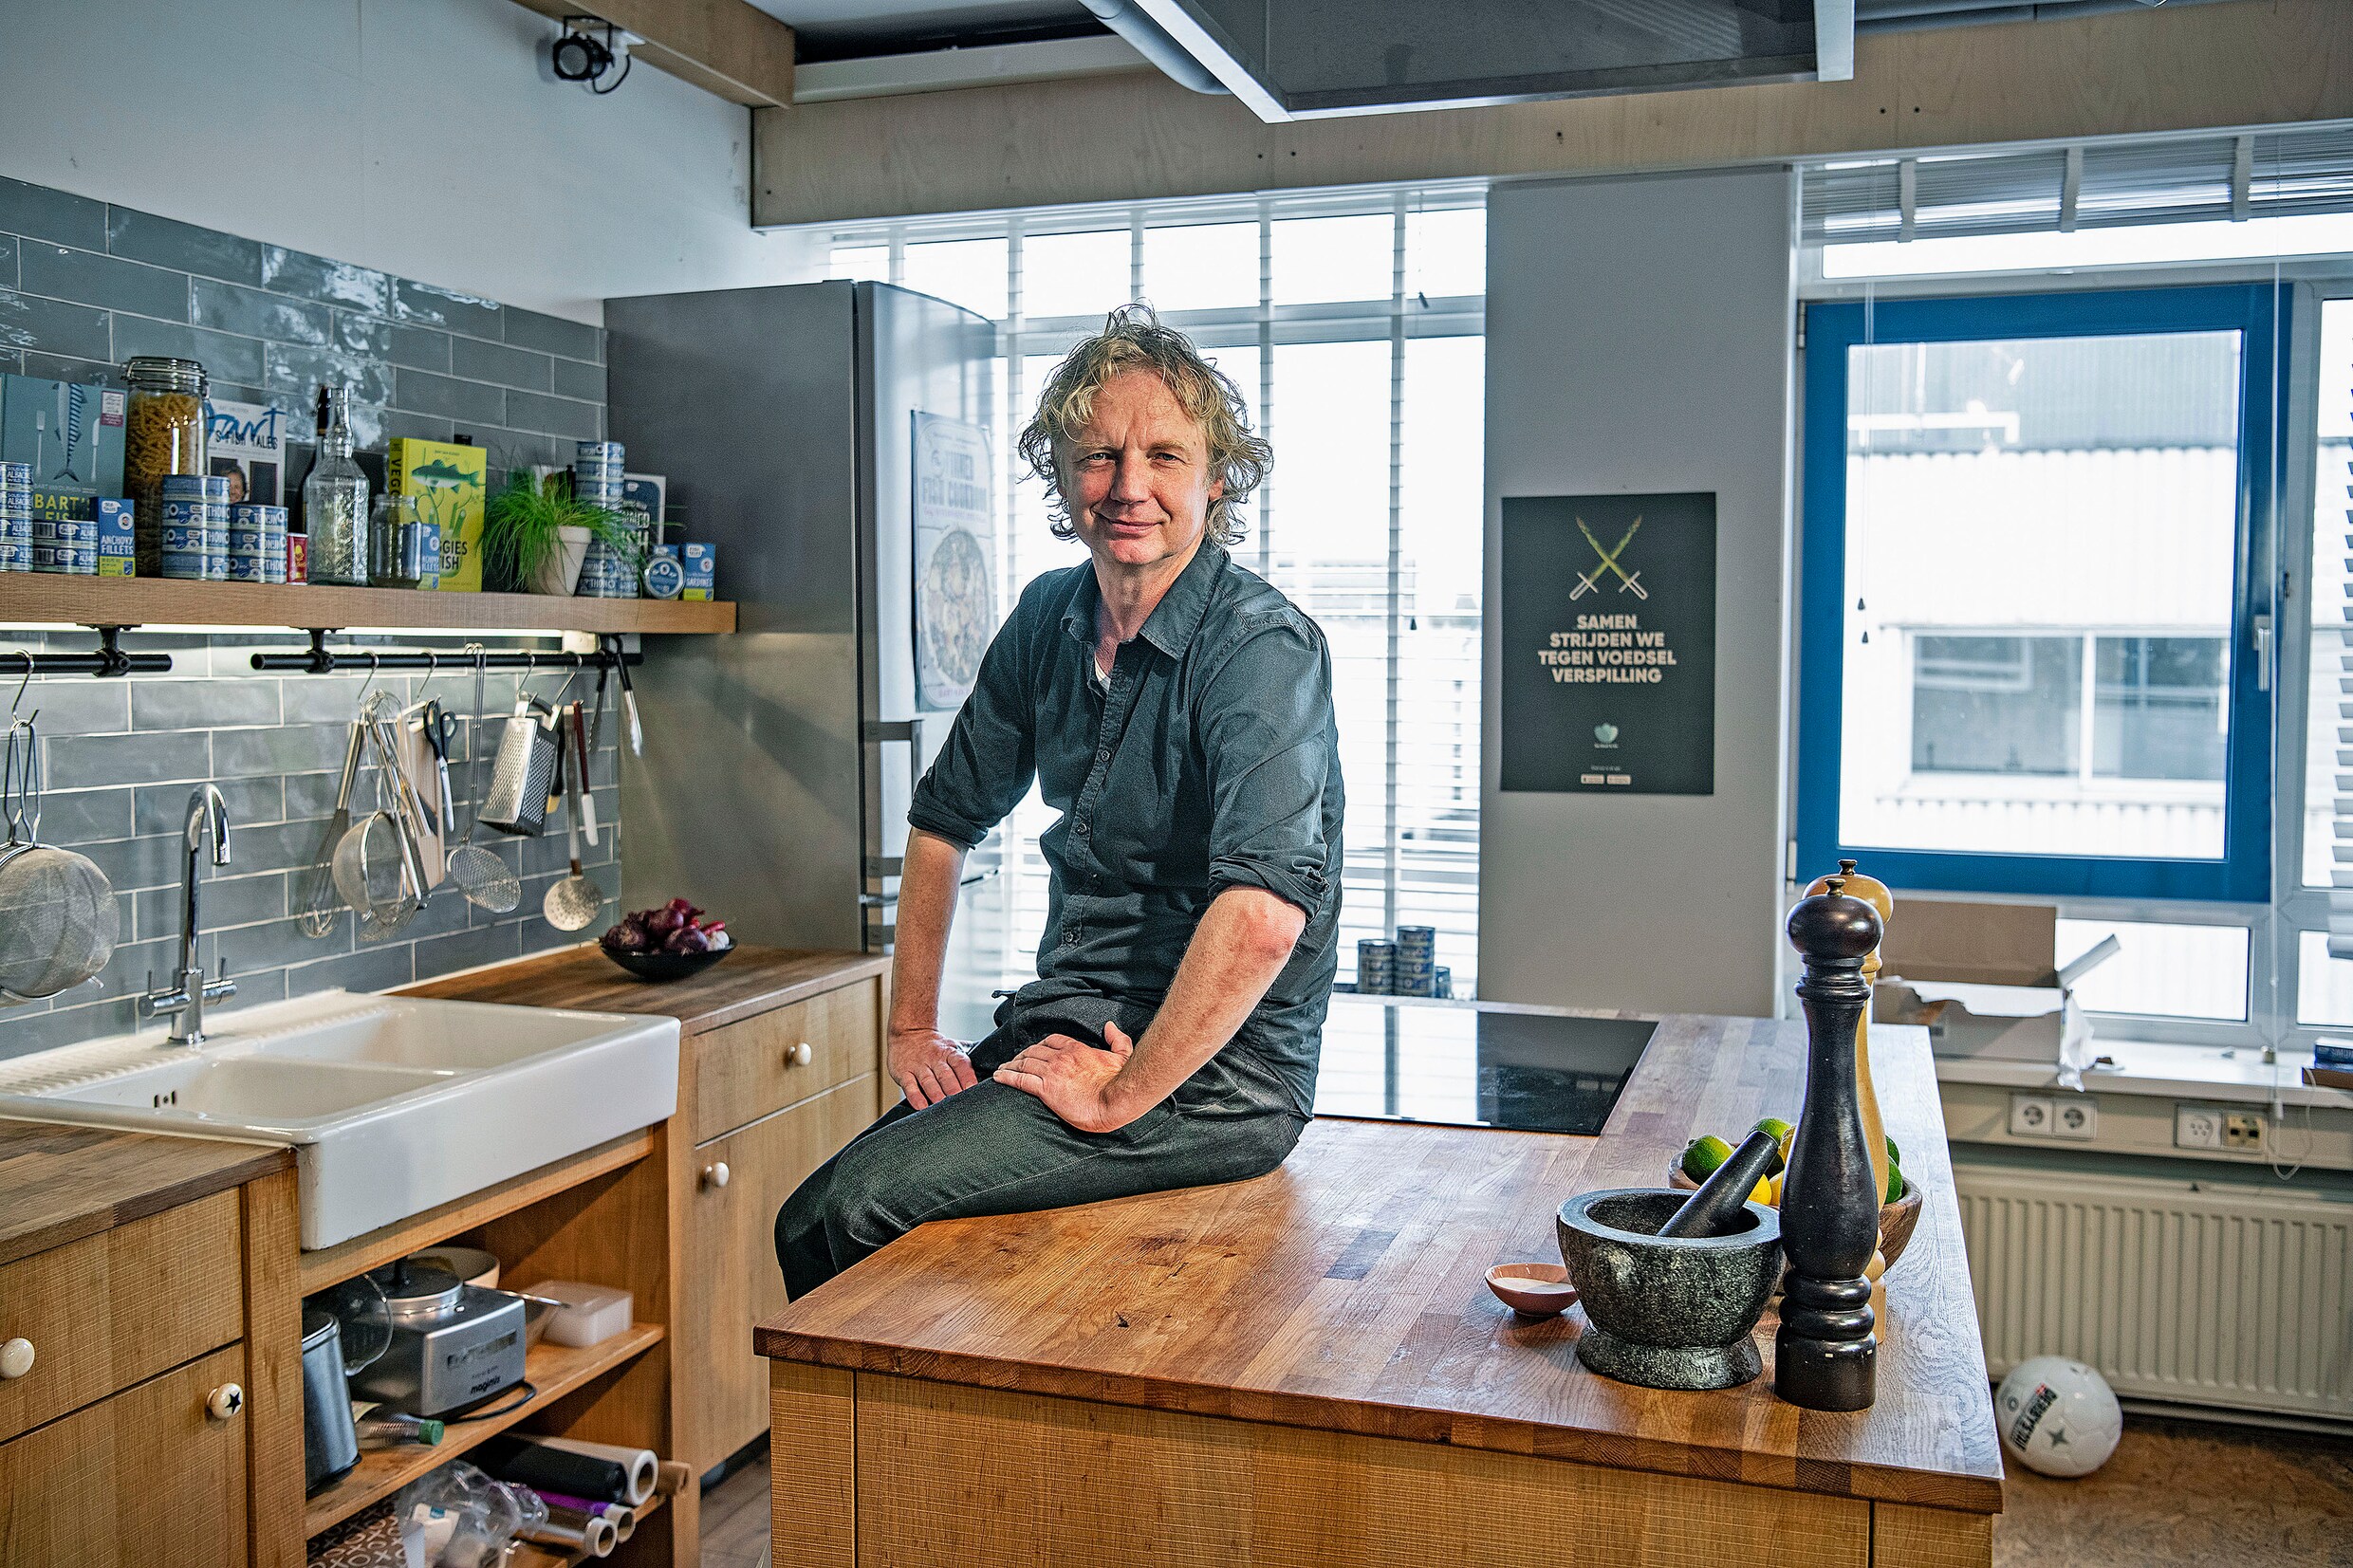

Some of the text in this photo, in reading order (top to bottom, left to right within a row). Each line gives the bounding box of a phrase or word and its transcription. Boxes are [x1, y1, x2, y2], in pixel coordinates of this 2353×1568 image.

[101, 535, 134, 545] ANCHOVY
[101, 544, 134, 555] FILLETS
[439, 556, 460, 570] ISH
[1576, 614, 1638, 630] SAMEN
[1549, 632, 1665, 648] STRIJDEN WE
[1538, 650, 1677, 666] TEGEN VOEDSEL
[1551, 668, 1662, 684] VERSPILLING
